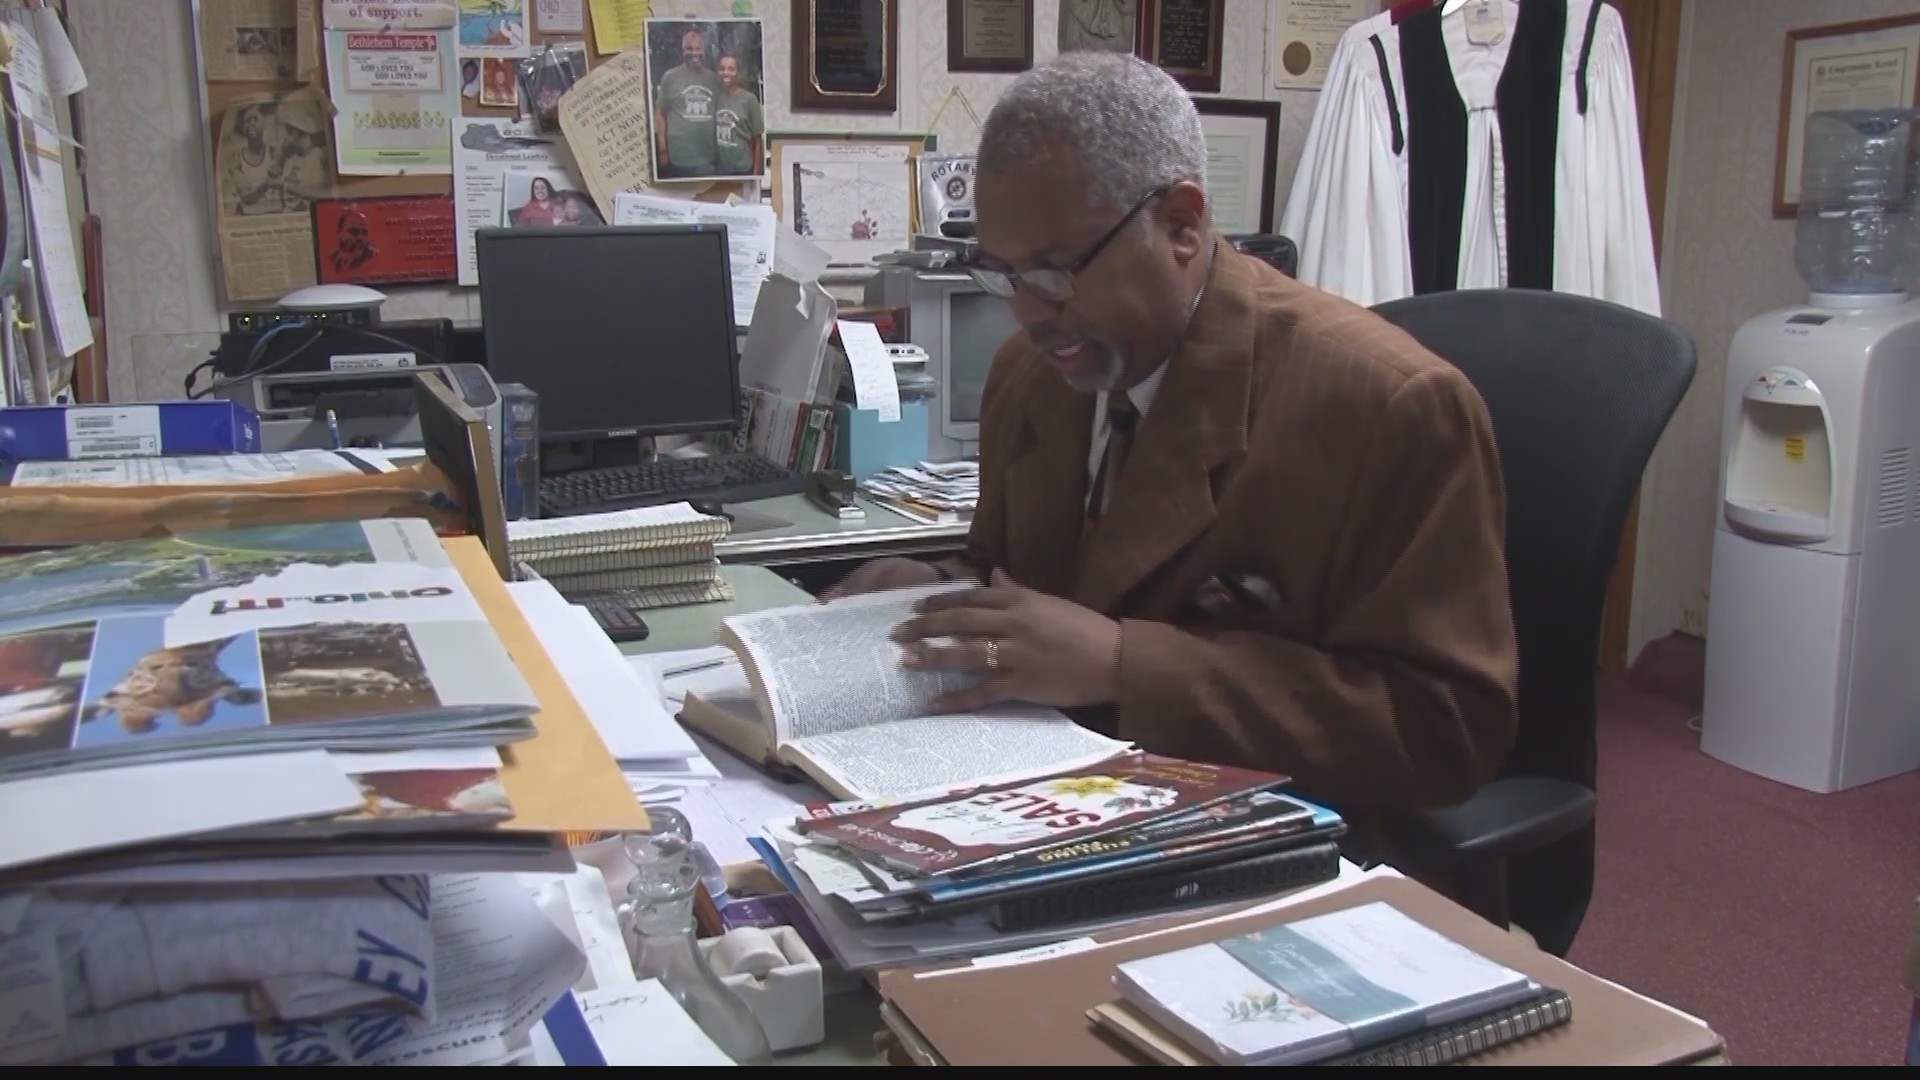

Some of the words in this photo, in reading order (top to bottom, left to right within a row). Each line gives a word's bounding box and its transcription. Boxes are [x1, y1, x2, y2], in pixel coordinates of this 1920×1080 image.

[349, 8, 362, 17] of
[367, 8, 424, 19] support.
[349, 35, 393, 48] Bethlehem
[395, 36, 424, 49] Temple
[597, 128, 617, 146] ACT
[971, 791, 1101, 830] SALE
